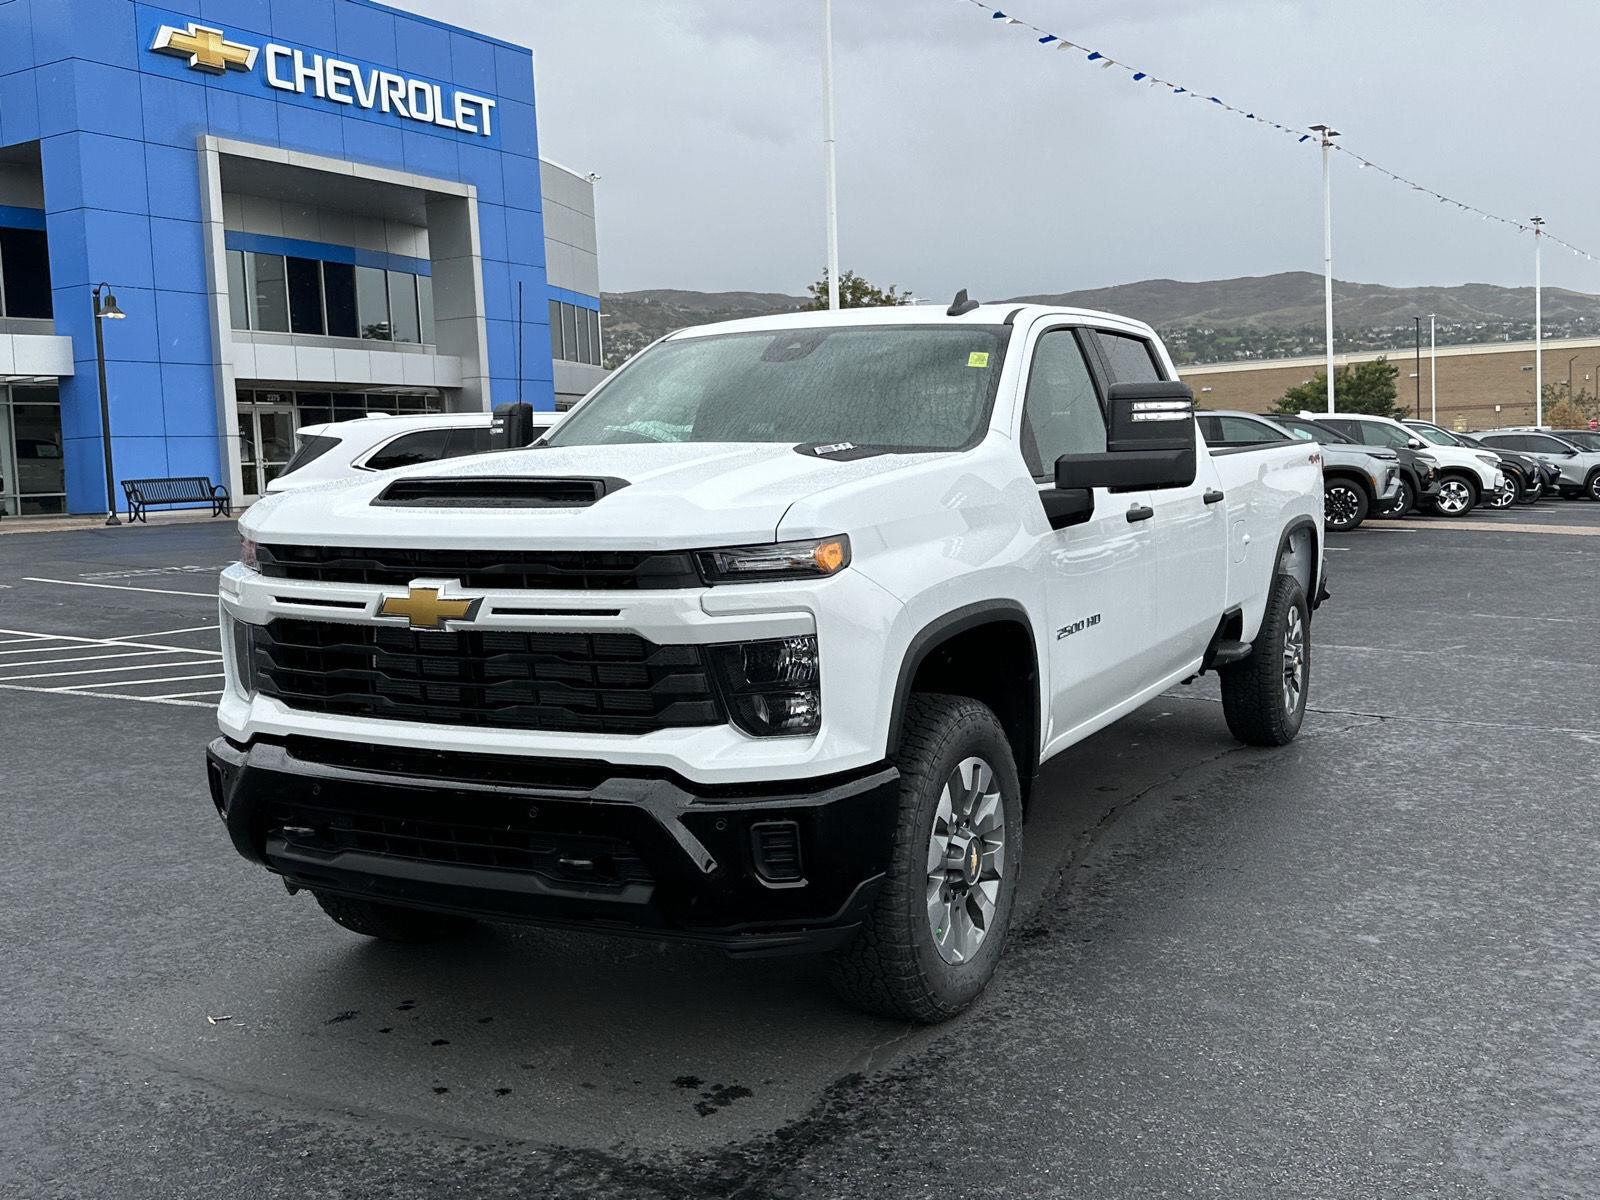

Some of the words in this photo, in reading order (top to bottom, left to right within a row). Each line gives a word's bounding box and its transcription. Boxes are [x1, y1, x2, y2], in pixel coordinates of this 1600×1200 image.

[265, 43, 496, 136] CHEVROLET
[1056, 620, 1084, 640] 2500
[1086, 614, 1101, 628] HD
